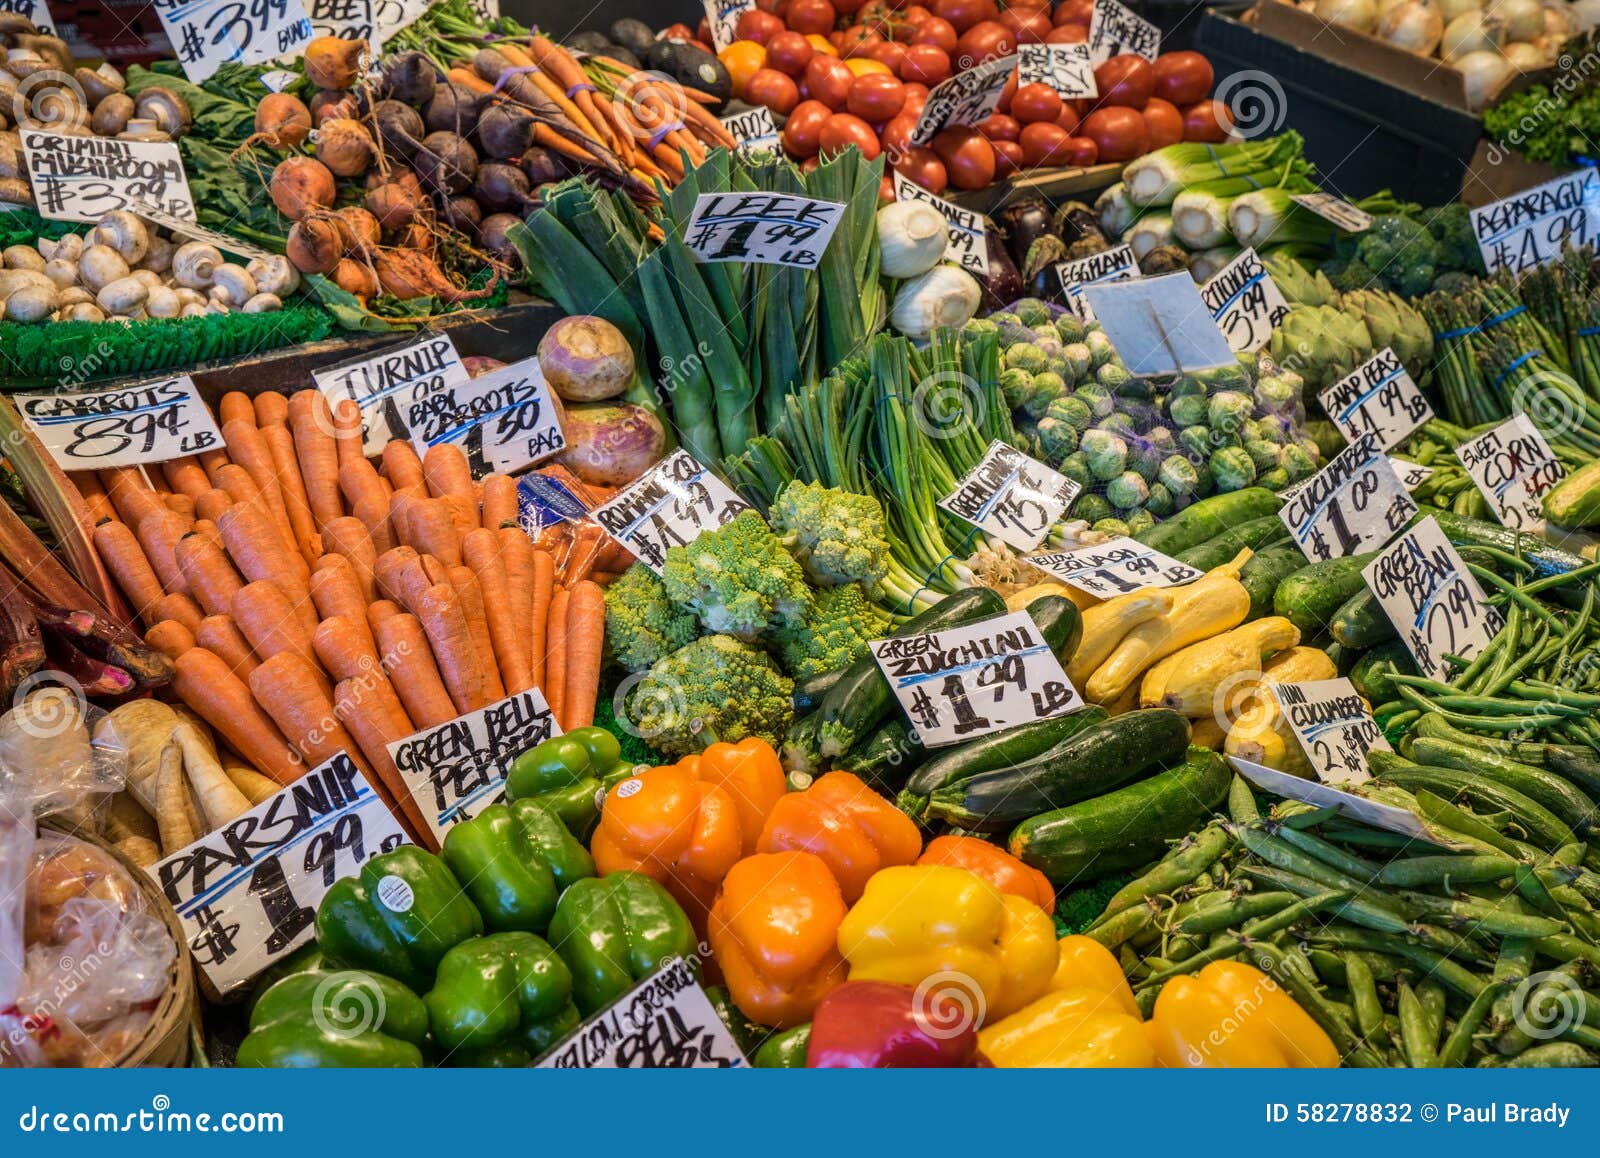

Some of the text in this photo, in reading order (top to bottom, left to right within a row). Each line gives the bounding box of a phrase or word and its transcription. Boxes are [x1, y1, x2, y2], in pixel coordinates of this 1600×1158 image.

[25, 133, 130, 158] CRIMINI
[31, 152, 183, 184] MUSHROOM
[698, 196, 835, 225] LEEK
[779, 251, 817, 266] LB
[962, 253, 984, 269] EA
[1061, 247, 1134, 287] EGGPLANT
[1201, 250, 1265, 315] RTICHOKES
[336, 341, 451, 400] TURNIP
[1327, 352, 1400, 417] SNAP PEAS
[25, 380, 191, 416] CARROTS
[408, 388, 457, 428] BABY
[422, 378, 538, 443] CARROTS
[64, 403, 217, 458] 89¢ LB
[528, 427, 563, 458] BAG
[1463, 431, 1503, 470] SWEET
[1484, 434, 1547, 488] CORN
[598, 453, 701, 535] ROMANSCO
[1289, 434, 1381, 529] CUCUMBER
[1404, 468, 1434, 487] EA
[1385, 494, 1418, 532] EA
[1029, 552, 1075, 566] YELLOW
[1053, 548, 1139, 575] SQUASH
[1162, 565, 1196, 584] LB
[1374, 533, 1427, 600] GREEN
[1403, 545, 1456, 615] BEAN
[876, 634, 942, 660] GREEN
[886, 626, 1038, 678] ZUCCHINI
[1031, 680, 1074, 717] LB
[1290, 694, 1372, 727] CUCUMBER
[395, 693, 552, 774] GREEN BELL
[1313, 739, 1343, 772] 2
[158, 753, 360, 905] PARSNIP
